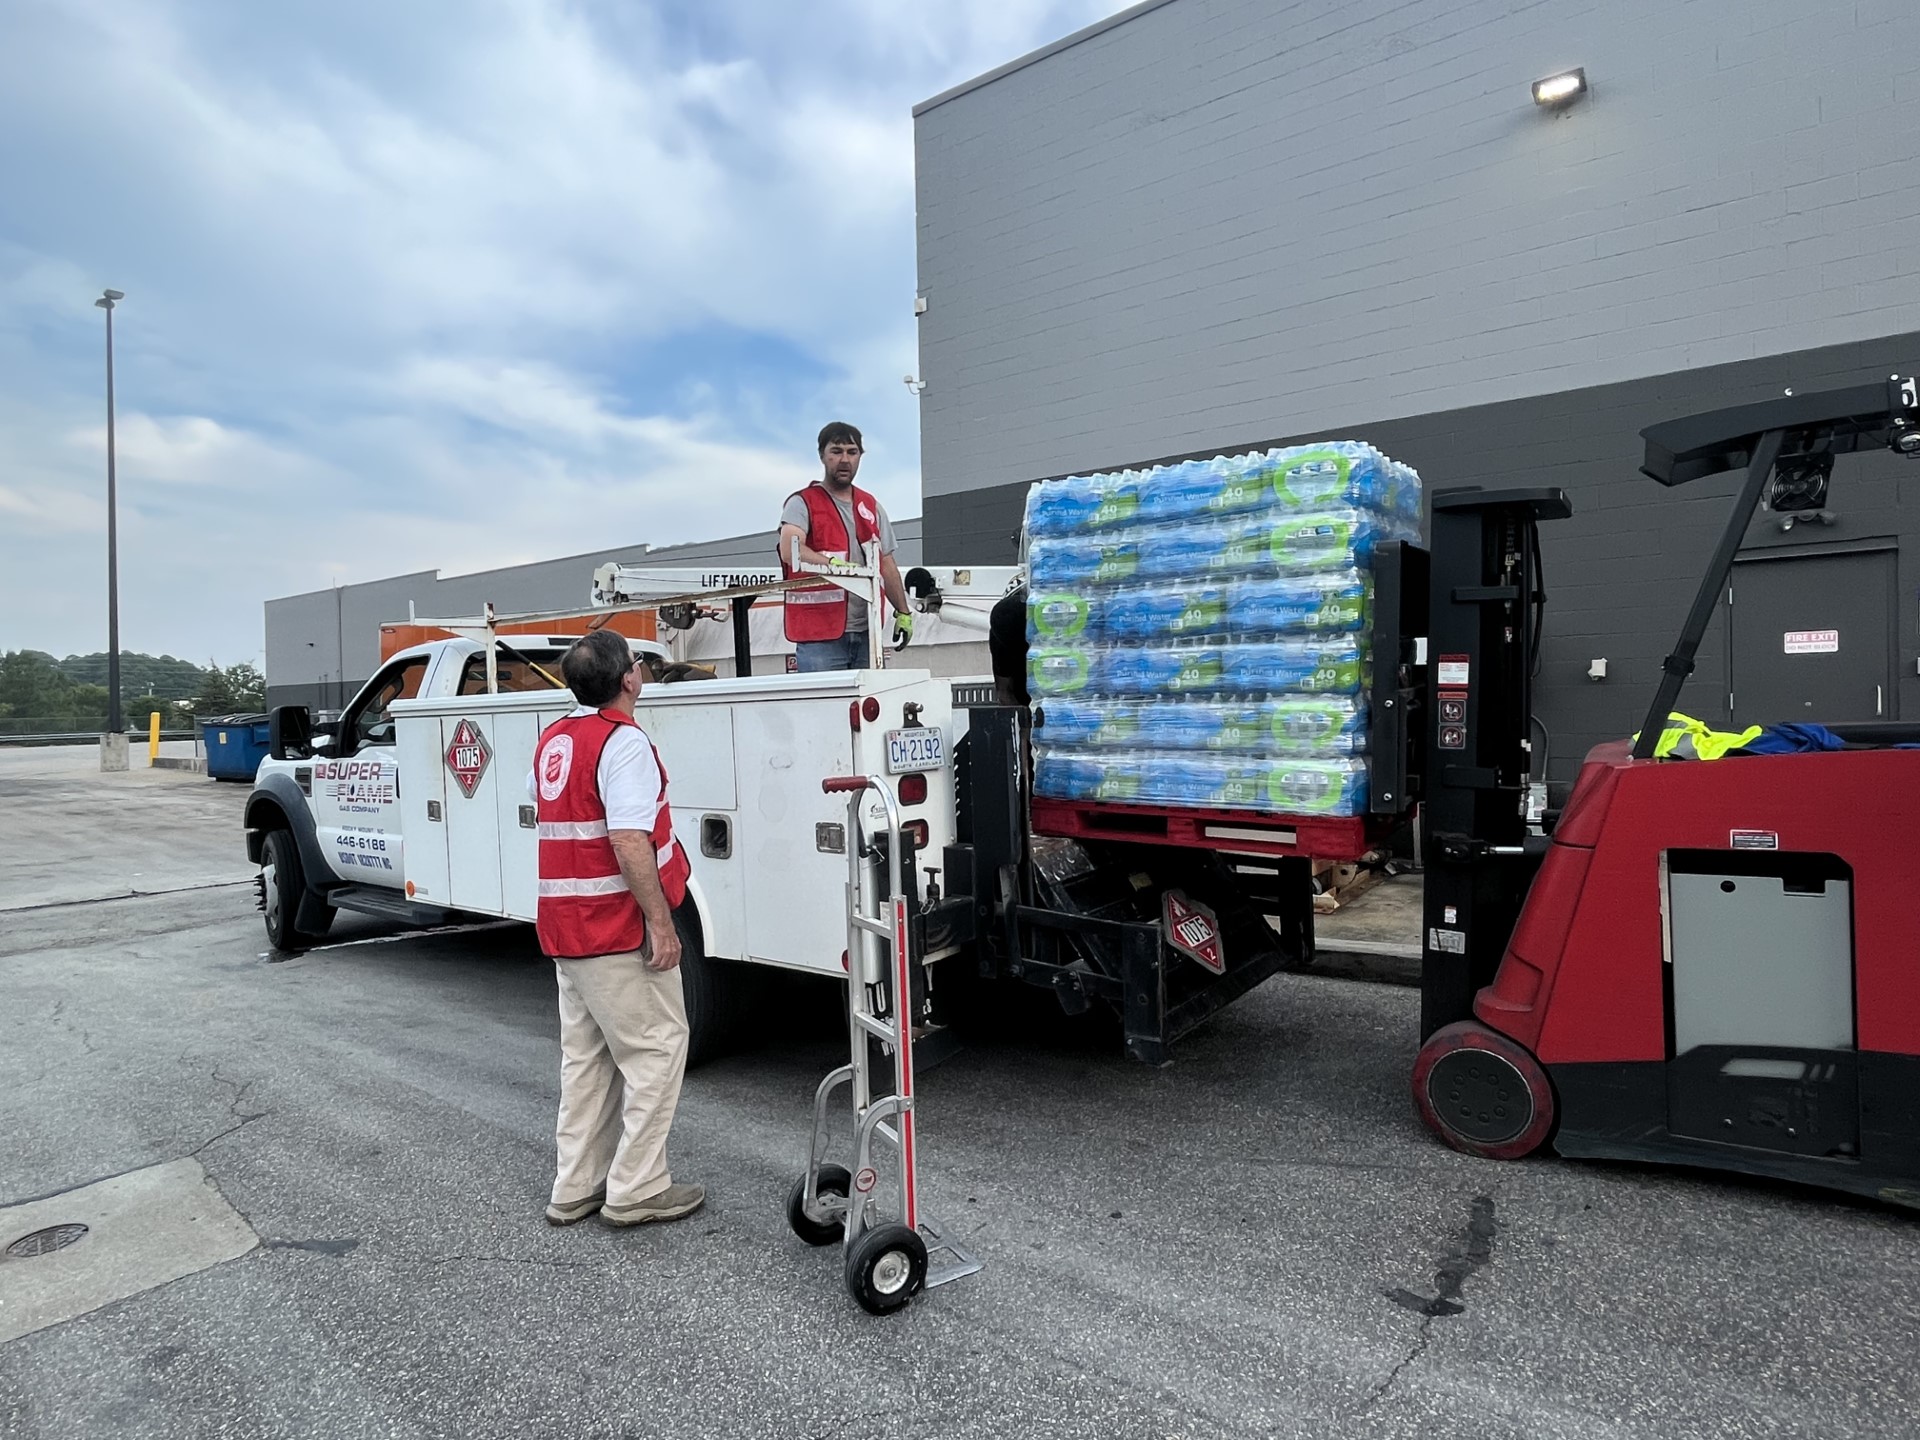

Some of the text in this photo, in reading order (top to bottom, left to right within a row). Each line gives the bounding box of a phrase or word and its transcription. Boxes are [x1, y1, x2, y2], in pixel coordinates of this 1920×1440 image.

[1224, 487, 1243, 498] 40
[1101, 504, 1118, 515] 40
[1184, 609, 1202, 621] 40
[1320, 604, 1340, 617] 40
[1786, 633, 1835, 642] FIRE EXIT
[1182, 669, 1199, 680] 40
[1316, 669, 1337, 681] 40
[458, 748, 479, 767] 1075
[327, 763, 381, 780] SUPER
[466, 775, 472, 784] 2
[337, 784, 393, 804] FLAME
[1181, 917, 1211, 945] 1075
[1207, 947, 1216, 961] 2
